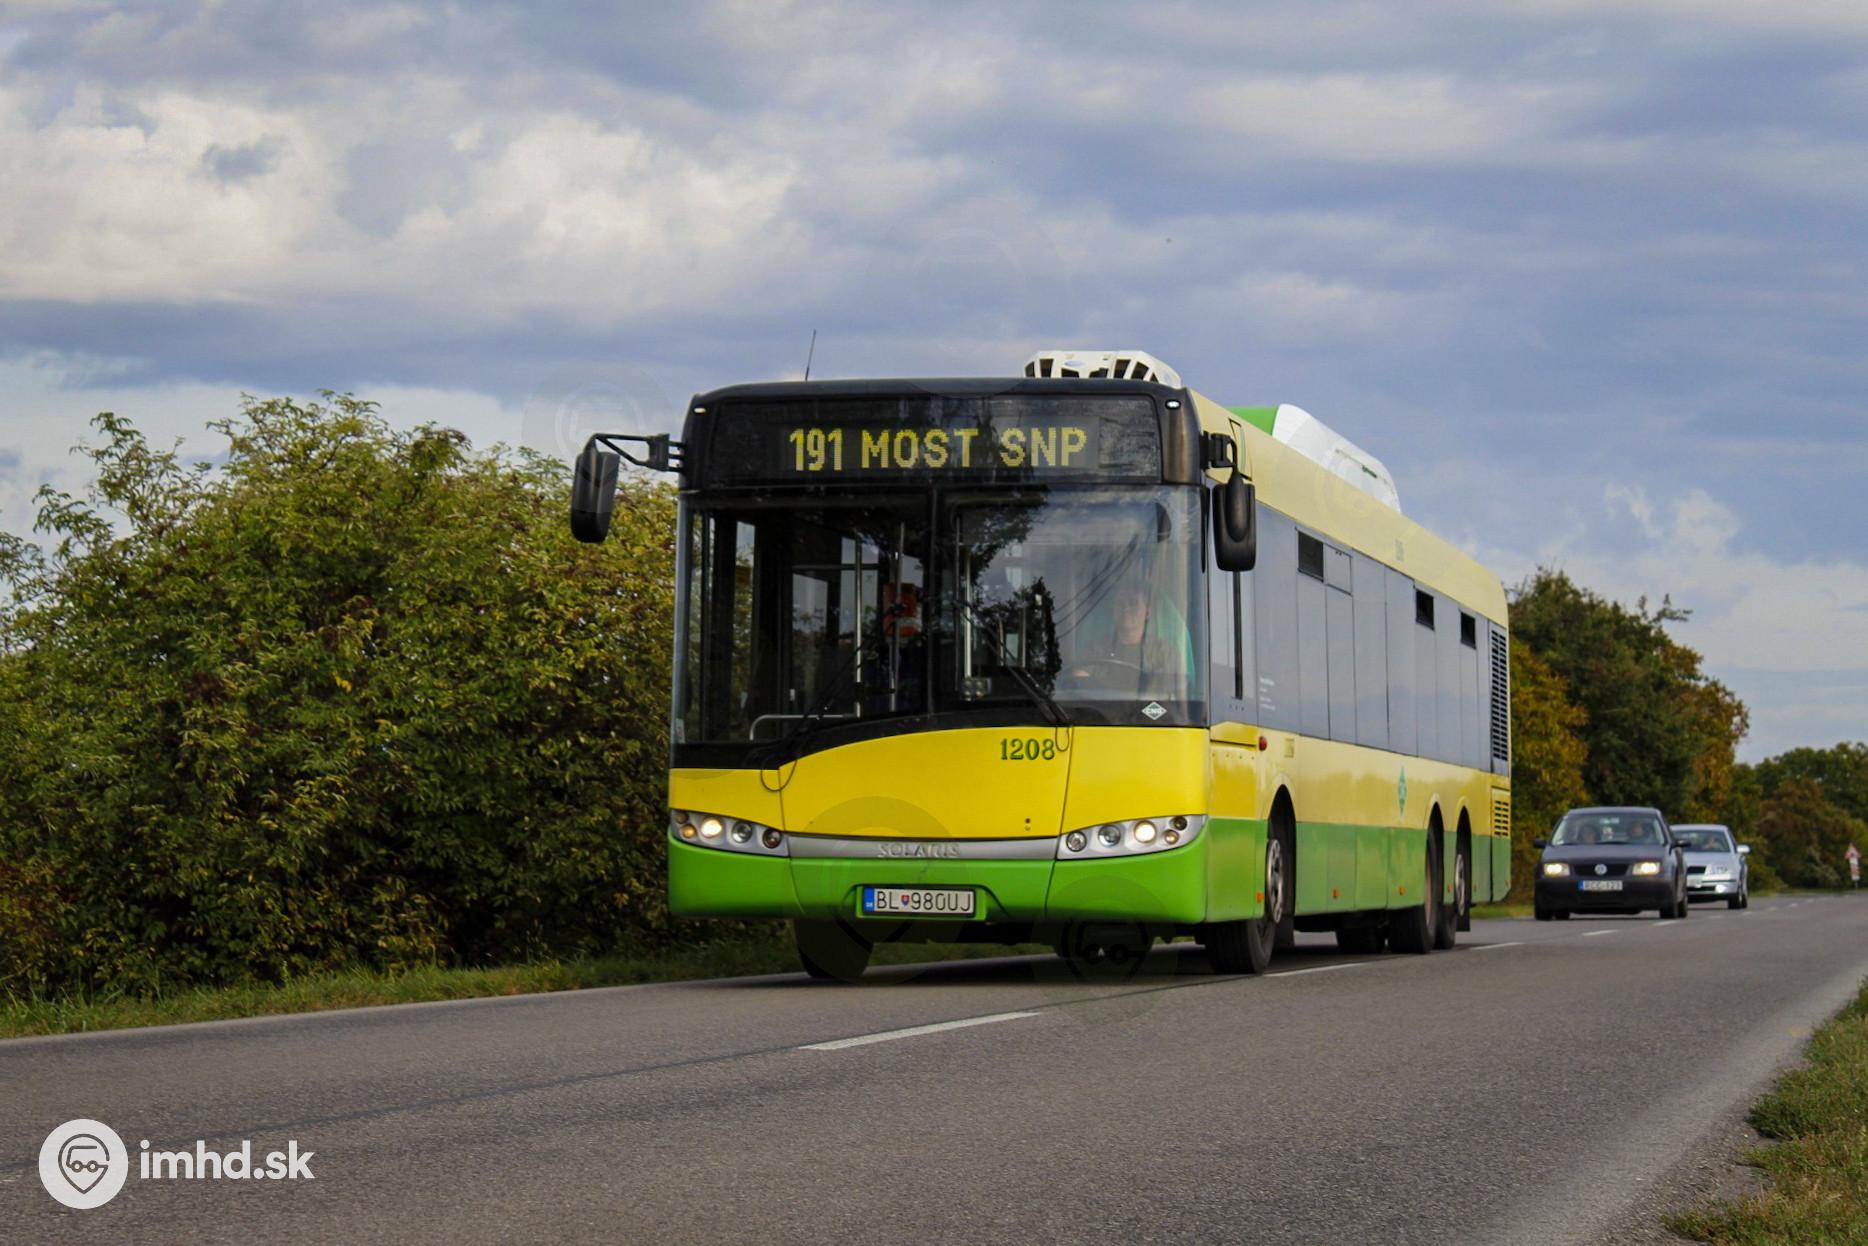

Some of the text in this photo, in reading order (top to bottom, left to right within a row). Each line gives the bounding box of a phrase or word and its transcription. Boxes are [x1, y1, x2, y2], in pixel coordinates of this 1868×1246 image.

[789, 427, 1087, 471] 191 MOST SNP
[1000, 738, 1055, 760] 1208
[878, 843, 960, 858] SOLARIS
[876, 891, 971, 911] BL 980UJ
